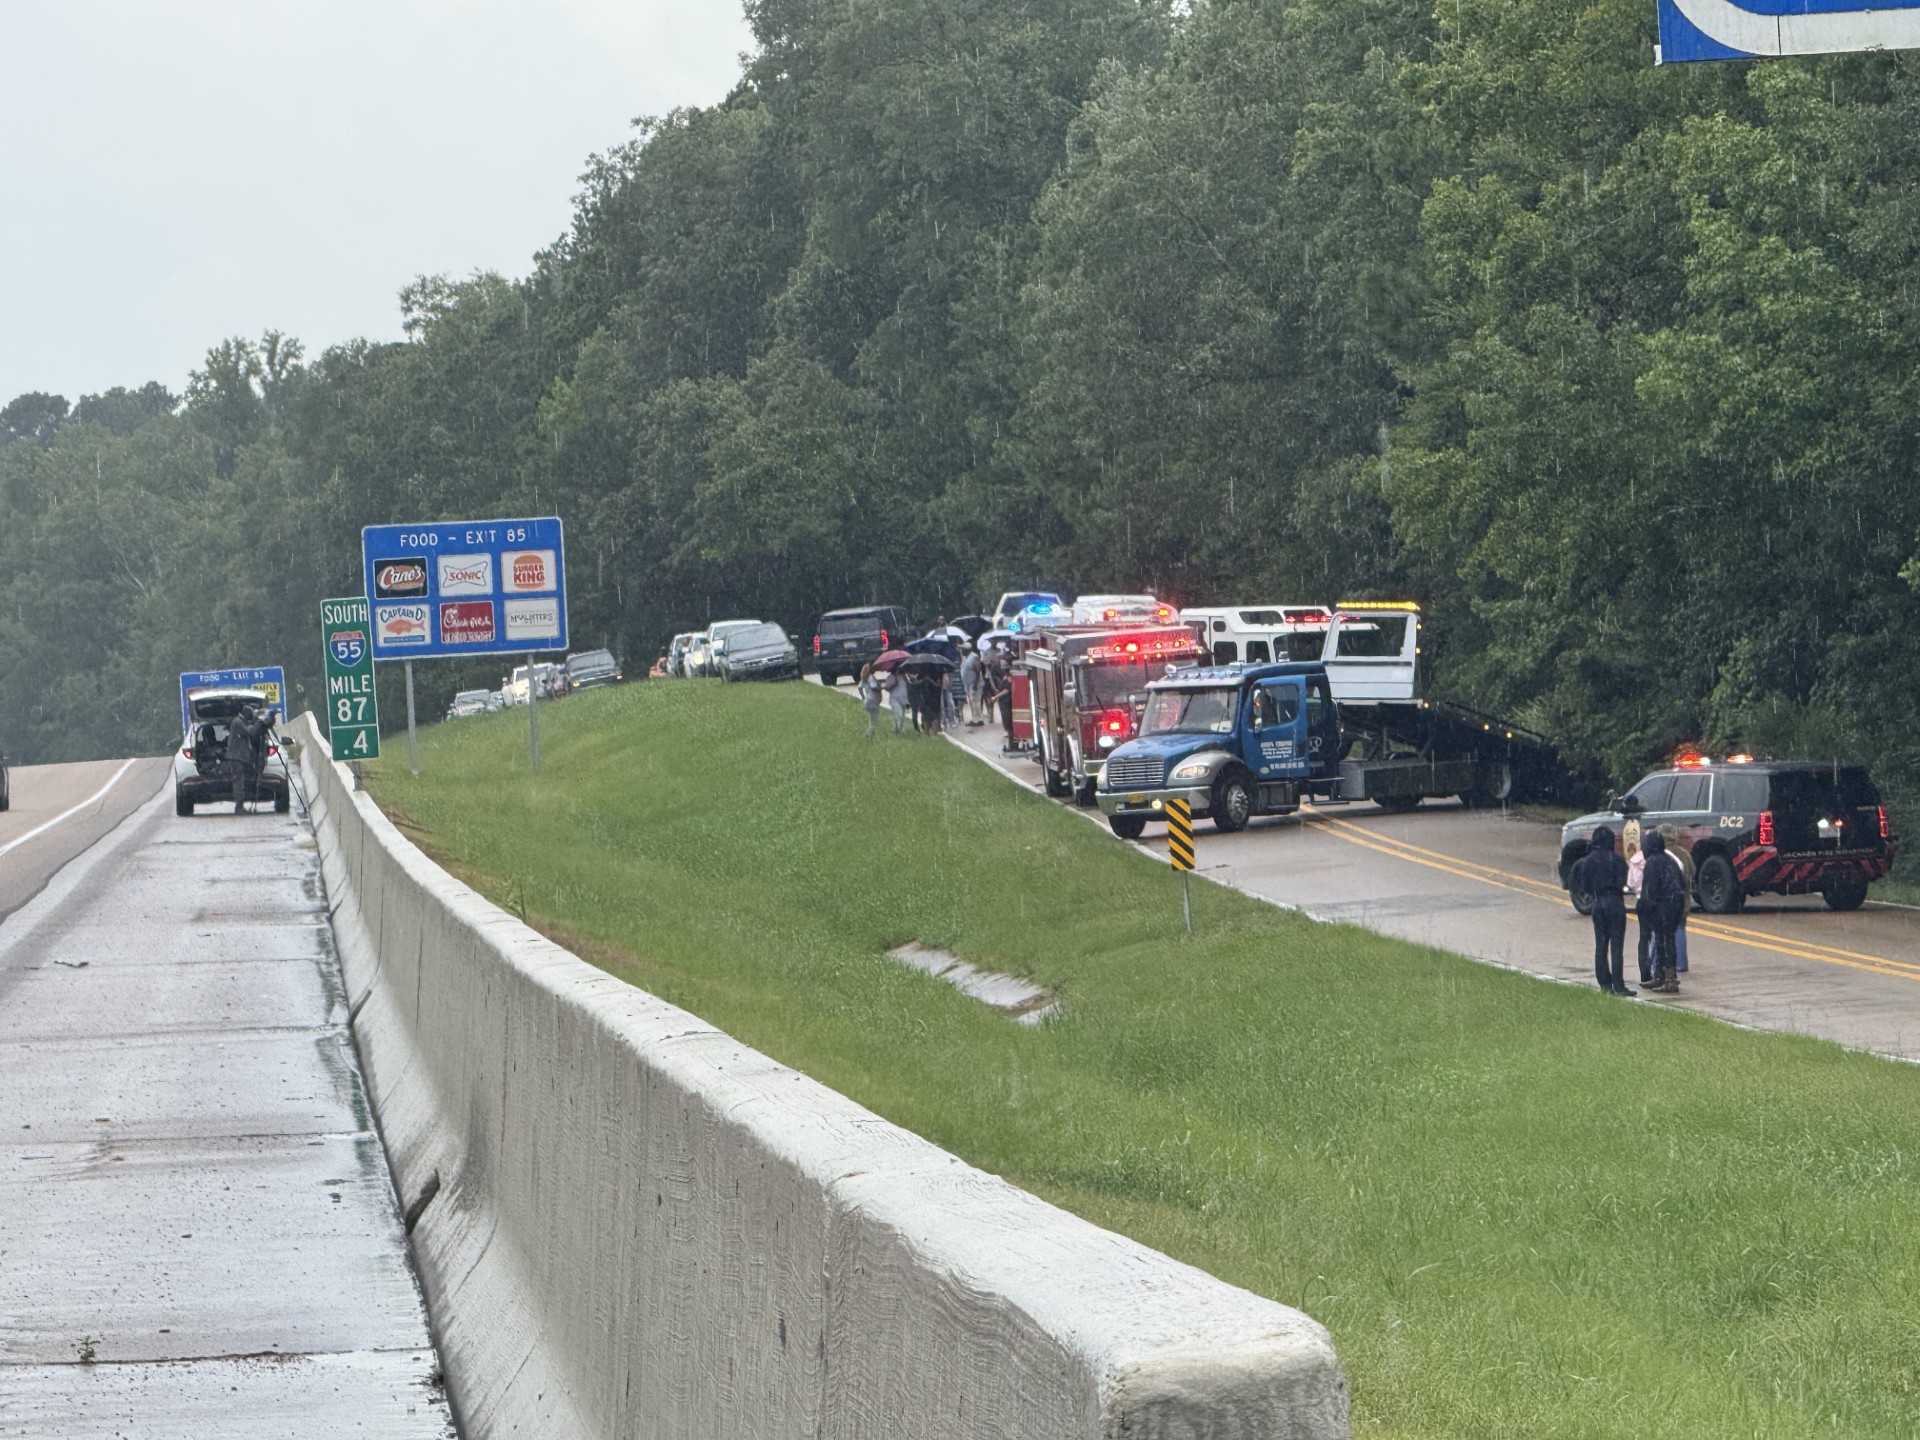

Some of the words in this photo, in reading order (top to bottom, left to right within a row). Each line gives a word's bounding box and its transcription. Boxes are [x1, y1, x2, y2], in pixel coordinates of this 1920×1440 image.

[400, 533, 438, 547] FOOD
[466, 530, 497, 544] EXIT
[507, 528, 526, 542] 85
[448, 570, 481, 581] SONIC
[513, 564, 544, 572] BURGER
[513, 571, 545, 583] KING
[324, 604, 368, 625] SOUTH
[380, 607, 415, 623] CAPTAIN
[337, 641, 361, 659] 55
[330, 674, 372, 695] MILE
[337, 697, 367, 722] 87
[1719, 816, 1745, 828] DC2
